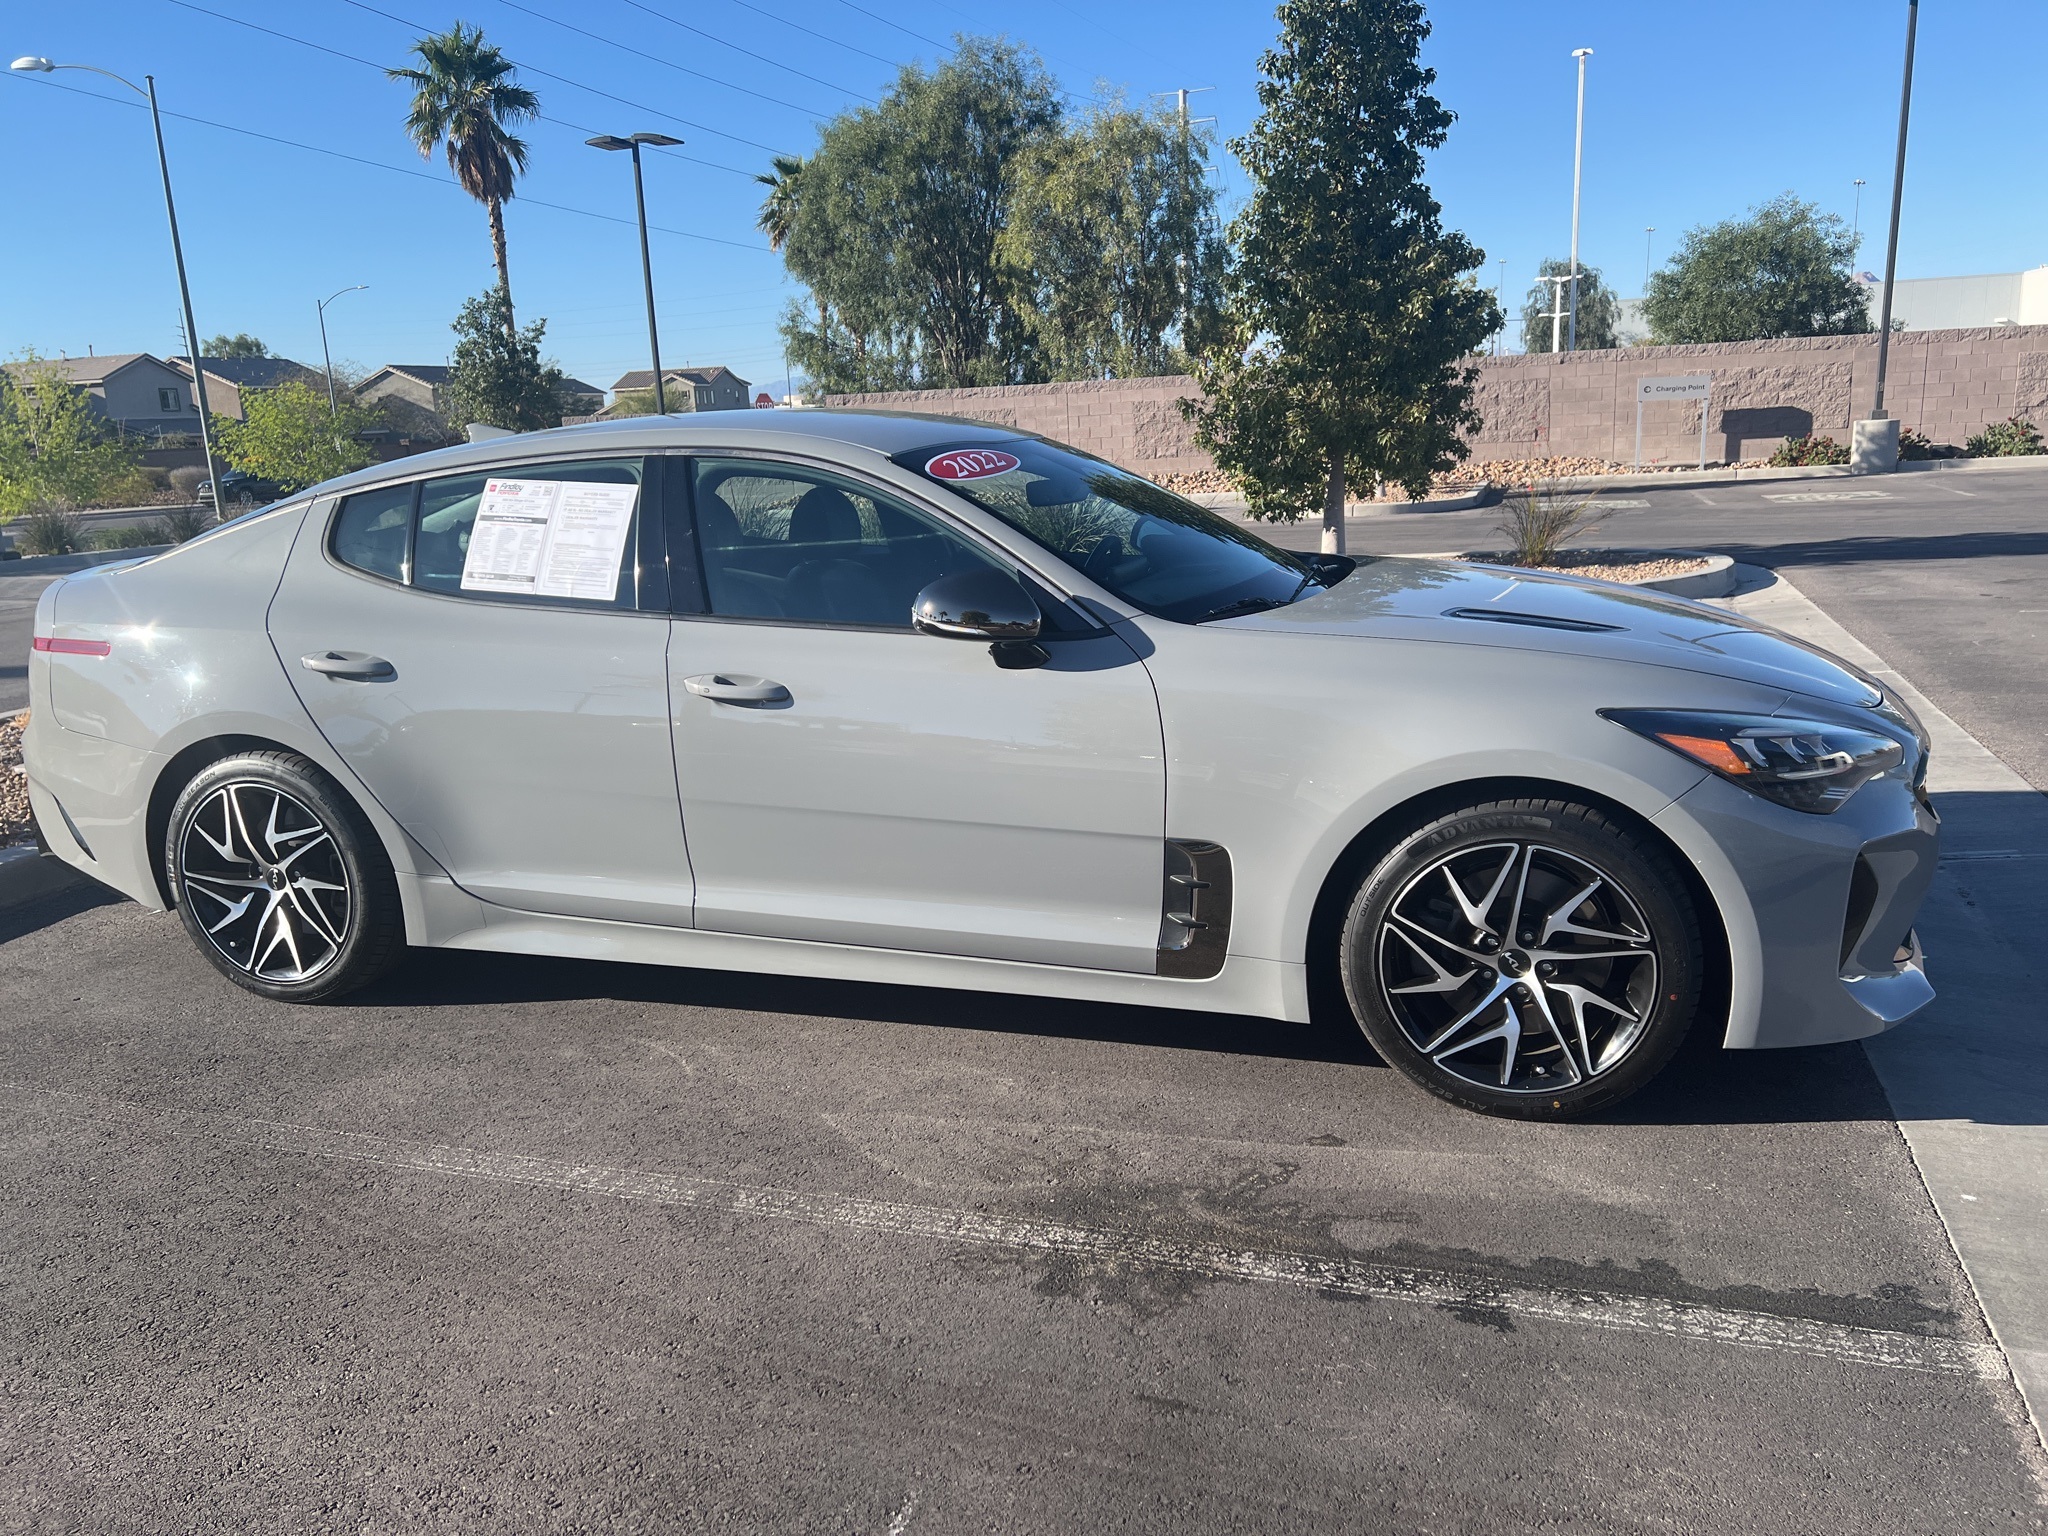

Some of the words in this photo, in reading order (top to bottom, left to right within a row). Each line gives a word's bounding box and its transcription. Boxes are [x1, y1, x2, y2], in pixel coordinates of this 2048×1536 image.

[943, 452, 1007, 477] 2022
[187, 771, 216, 799] SEASON
[1359, 877, 1385, 917] OUTSIDE
[1401, 1061, 1455, 1101] SEASON
[1459, 1096, 1488, 1112] ALL
